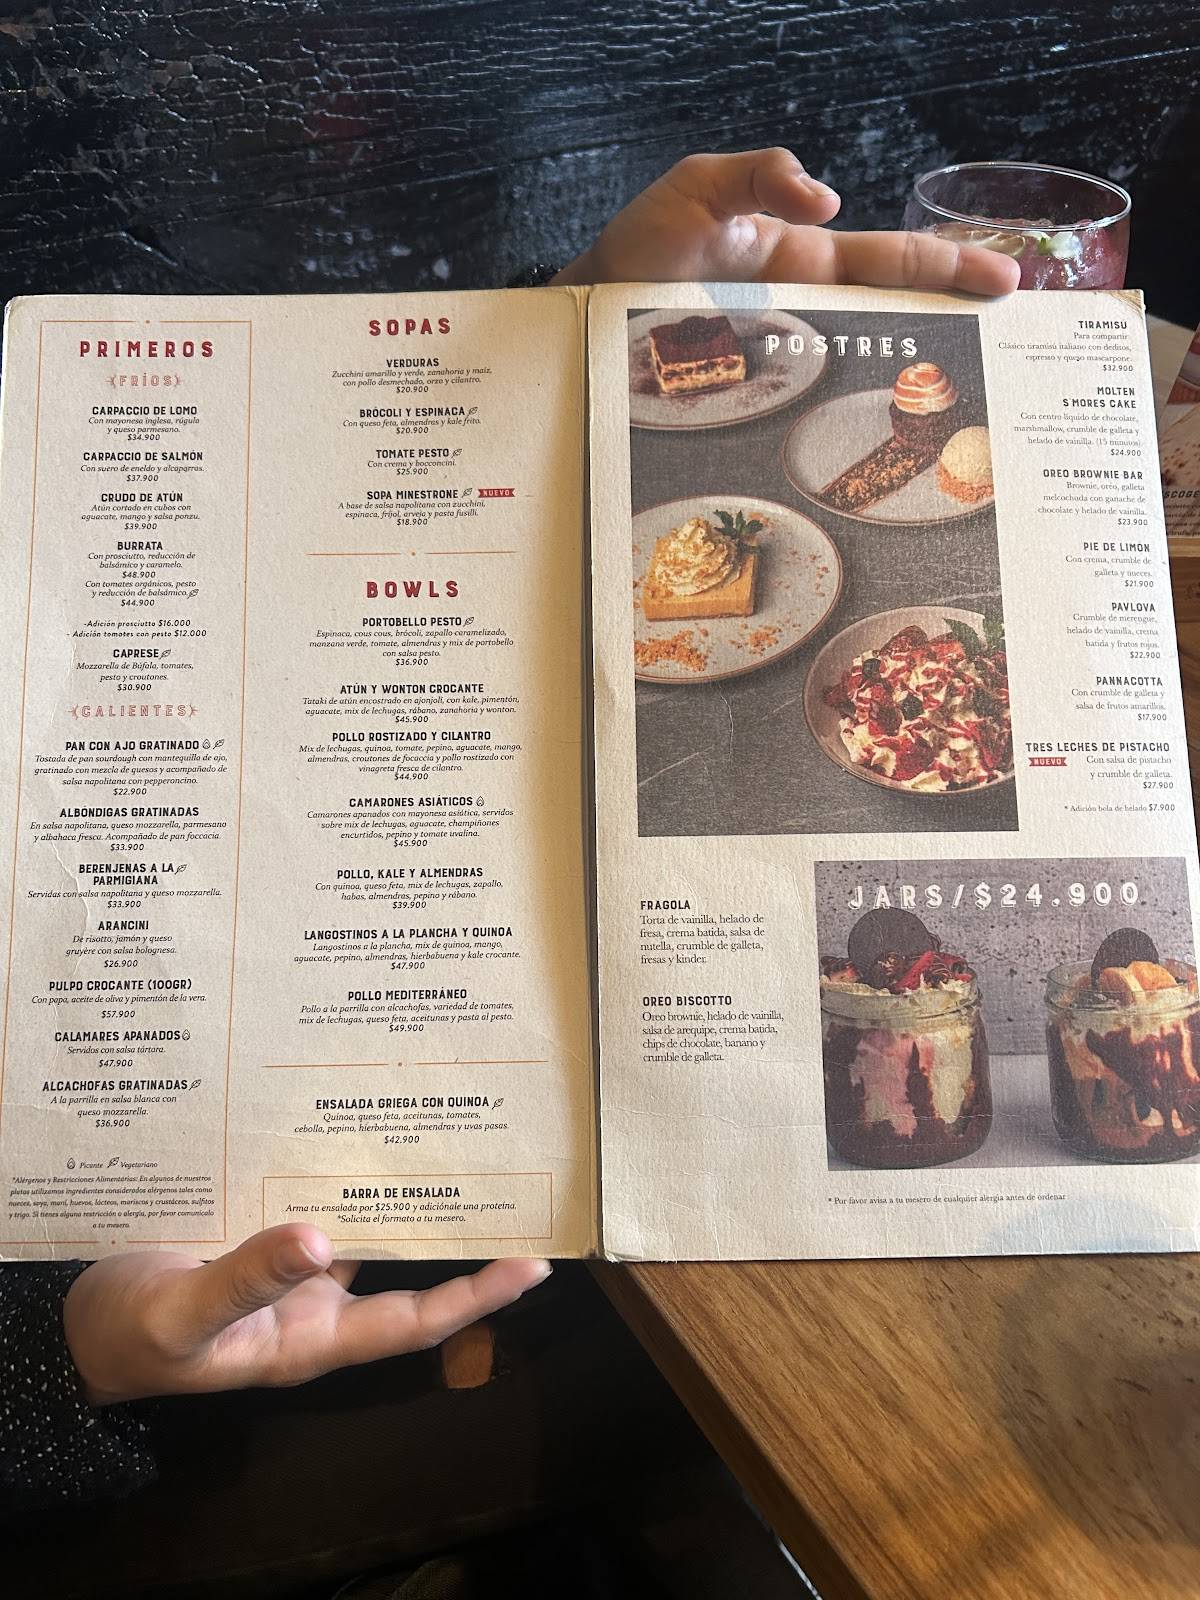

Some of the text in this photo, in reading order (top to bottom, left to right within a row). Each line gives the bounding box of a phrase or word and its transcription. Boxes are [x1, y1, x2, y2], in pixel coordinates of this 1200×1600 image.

[369, 317, 451, 337] SOPAS
[80, 340, 213, 358] PRIMEROS
[764, 335, 919, 358] POSTRES
[386, 357, 440, 368] VERDURAS
[1102, 364, 1134, 372] $32.900
[396, 385, 429, 394] $20.900
[1097, 386, 1135, 396] MOLTEN
[1109, 399, 1137, 409] CAKE
[92, 406, 197, 416] CARPACCIO DE LOMO
[405, 408, 411, 417] Y
[415, 406, 465, 417] ESPINACA
[396, 426, 429, 435] $20.900
[127, 433, 161, 441] $34.900
[83, 452, 141, 461] CARPACCIO
[145, 452, 158, 461] DE
[375, 448, 449, 459] TOMATE PESTO
[1110, 448, 1142, 457] $24.900
[396, 466, 429, 476] $25.900
[1043, 468, 1143, 480] OREO BROWNIE BAR
[126, 474, 159, 482] $37.900
[101, 493, 136, 503] CRUDO
[139, 493, 153, 502] DE
[366, 489, 458, 500] SOPA MINESTRONE
[481, 487, 512, 499] NUEVO
[124, 522, 158, 531] $39.900
[396, 517, 428, 526] $18.900
[1117, 517, 1148, 526] $23.900
[117, 541, 163, 551] BURRATA
[1083, 541, 1099, 551] PIE
[1103, 542, 1116, 552] DE
[122, 570, 156, 579] $48.900
[1124, 579, 1154, 588] $21.900
[366, 580, 459, 599] BOWLS
[120, 598, 155, 608] $44.900
[1111, 602, 1156, 612] PAVLOVA
[158, 619, 191, 627] $16.000
[362, 616, 462, 627] PORTOBELLO PESTO
[174, 629, 207, 638] $12.000
[113, 648, 160, 658] CAPRESE
[1130, 651, 1161, 659] $22.900
[395, 658, 429, 667] $36.900
[1096, 675, 1163, 686] PANNACOTTA
[117, 683, 152, 692] $30.900
[371, 684, 377, 694] Y
[381, 684, 426, 694] WONTON
[429, 683, 484, 694] CROCANTE
[81, 704, 187, 718] CALIENTES
[395, 715, 429, 724] $45.900
[1137, 713, 1167, 721] $17.900
[332, 730, 491, 742] POLLO ROSTIZADO Y CILANTRO
[65, 740, 199, 751] PAN CON AJO GRATINADO
[1025, 742, 1170, 753] TRES LECHES DE PISTACHO
[1033, 756, 1062, 765] NUEVO
[394, 772, 429, 781] $44.900
[1143, 781, 1174, 789] $27.900
[113, 787, 147, 796] $22.900
[349, 797, 414, 808] CAMARONES
[1148, 803, 1175, 812] $7.900
[131, 806, 199, 817] GRATINADAS
[110, 843, 145, 852] $33.900
[393, 839, 428, 848] $45.900
[78, 862, 174, 874] BERENJENAS A LA
[337, 867, 483, 880] POLLO, KALE Y ALMENDRAS
[93, 875, 158, 886] PARMIGIANA
[847, 881, 1138, 910] JARS/$24.900
[107, 900, 142, 909] $33.900
[392, 900, 427, 910] $39.900
[640, 899, 691, 911] FRAGOLA
[639, 913, 764, 926] Torta de vainilla, helado de
[97, 920, 149, 931] ARANCINI
[304, 926, 513, 941] LANGOSTINOS A LA PLANCHA Y QUINOA
[640, 926, 765, 940] fresa, crema batida, salsa de
[640, 940, 675, 953] nutella,
[716, 940, 729, 950] de
[730, 940, 764, 953] galleta,
[104, 959, 138, 968] $26.900
[641, 955, 666, 964] fresas
[668, 957, 674, 966] y
[390, 961, 426, 971] $47.900
[49, 978, 192, 992] PULPO CROCANTE (100GR)
[348, 990, 382, 1001] POLLO
[642, 995, 732, 1007] OREO BISCOTTO
[101, 1010, 136, 1019] $57.900
[389, 1023, 425, 1033] $49.900
[54, 1030, 181, 1042] CALAMARES APANADOS
[98, 1059, 133, 1068] $47.900
[42, 1079, 188, 1092] ALCACHOFAS GRATINADAS
[316, 1096, 489, 1110] ENSALADA GRIEGA CON QUINOA
[95, 1119, 131, 1128] $36.900
[384, 1135, 420, 1145] $42.900
[343, 1186, 460, 1199] BARRA DE ENSALADA
[285, 1203, 308, 1212] Arma
[321, 1202, 357, 1212] ensalada
[359, 1203, 373, 1213] por
[375, 1202, 411, 1211] $25.900
[413, 1204, 417, 1212] y
[463, 1202, 478, 1211] una
